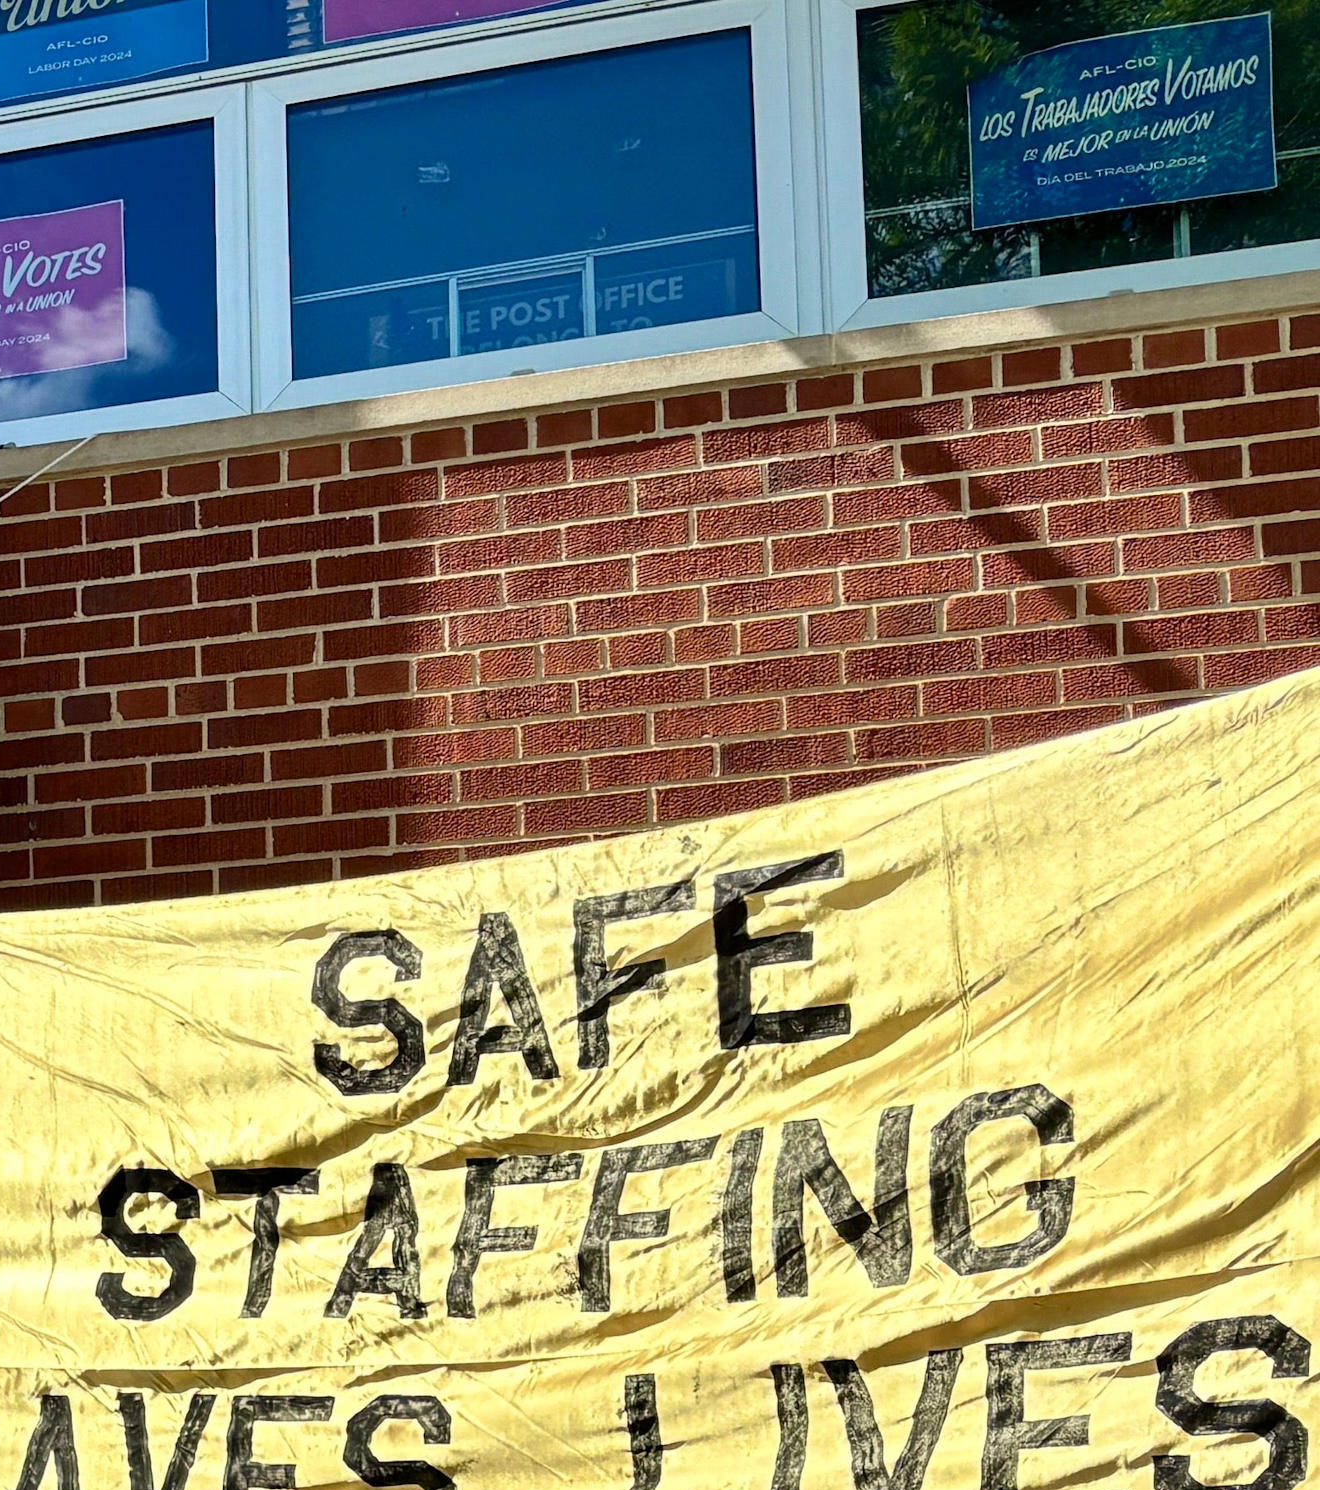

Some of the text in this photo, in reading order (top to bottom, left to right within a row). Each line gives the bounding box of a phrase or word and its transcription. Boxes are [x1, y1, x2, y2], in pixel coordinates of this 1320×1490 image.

[47, 35, 108, 51] AFL-CIO
[28, 50, 132, 74] LABOR DAY 2024
[1079, 56, 1157, 81] AFL-CIO
[979, 55, 1260, 142] LOS TRABAJADORES VOTAMOS
[1023, 109, 1215, 163] ES MEJOR EN LA UNIÓN
[1065, 171, 1092, 182] DEL
[1095, 161, 1164, 177] TRABAJO
[1166, 155, 1207, 169] 2024
[2, 243, 106, 298] VOTES
[5, 304, 16, 314] IN
[16, 302, 24, 312] A
[26, 289, 76, 313] UNION
[490, 295, 570, 330] POST
[18, 332, 51, 345] 2024
[311, 850, 850, 1095] SAFE
[95, 1082, 1075, 1321] STAFFING
